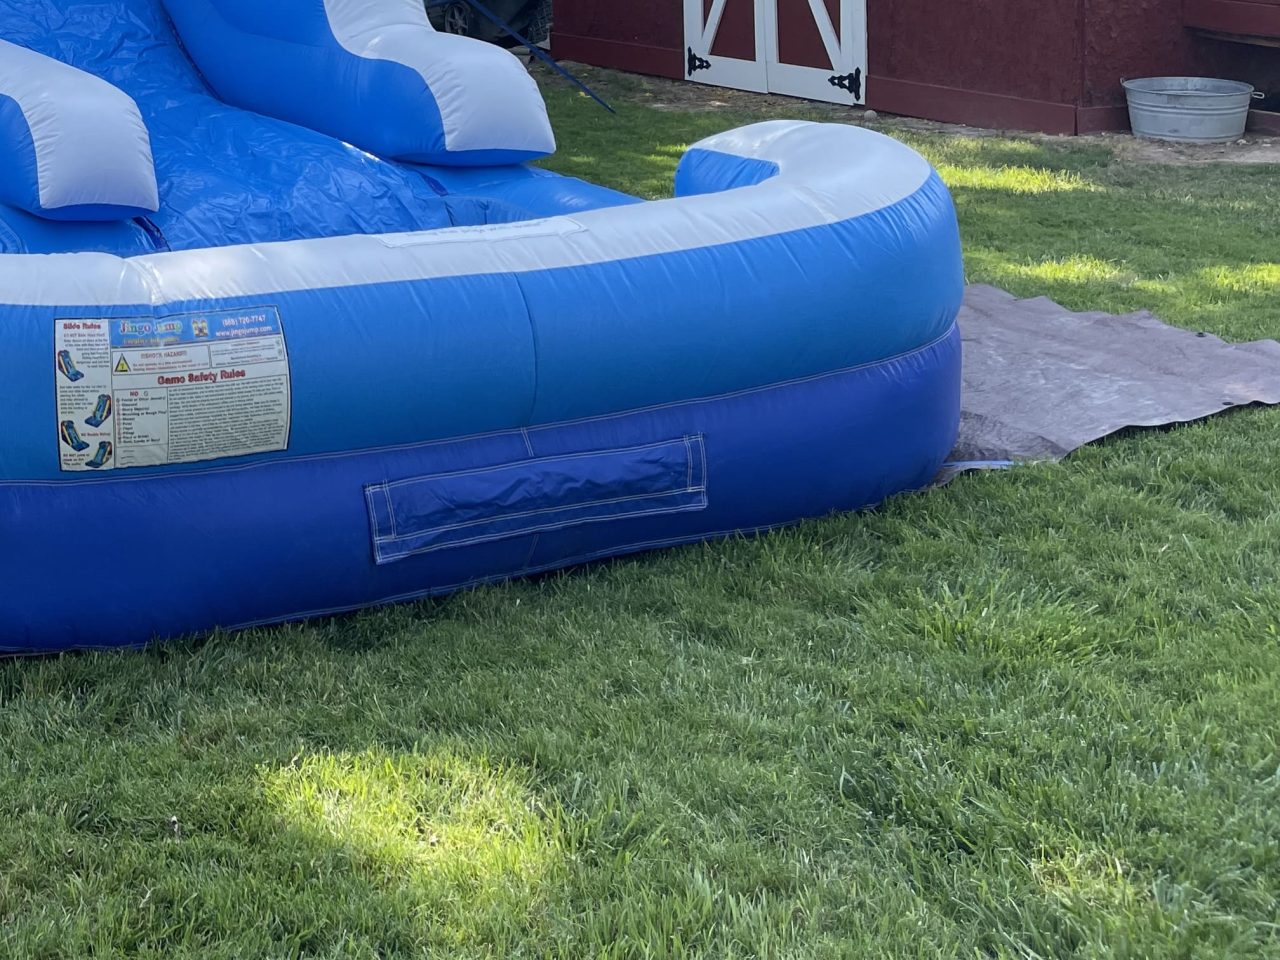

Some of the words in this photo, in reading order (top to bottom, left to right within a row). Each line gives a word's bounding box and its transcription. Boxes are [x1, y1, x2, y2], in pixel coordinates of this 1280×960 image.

[63, 322, 80, 330] Slide
[82, 322, 101, 330] Rules
[120, 320, 152, 336] Jingo
[215, 326, 273, 337] www.jingojump.com
[157, 375, 186, 385] Game
[187, 371, 218, 383] Safety
[220, 368, 246, 380] Rules
